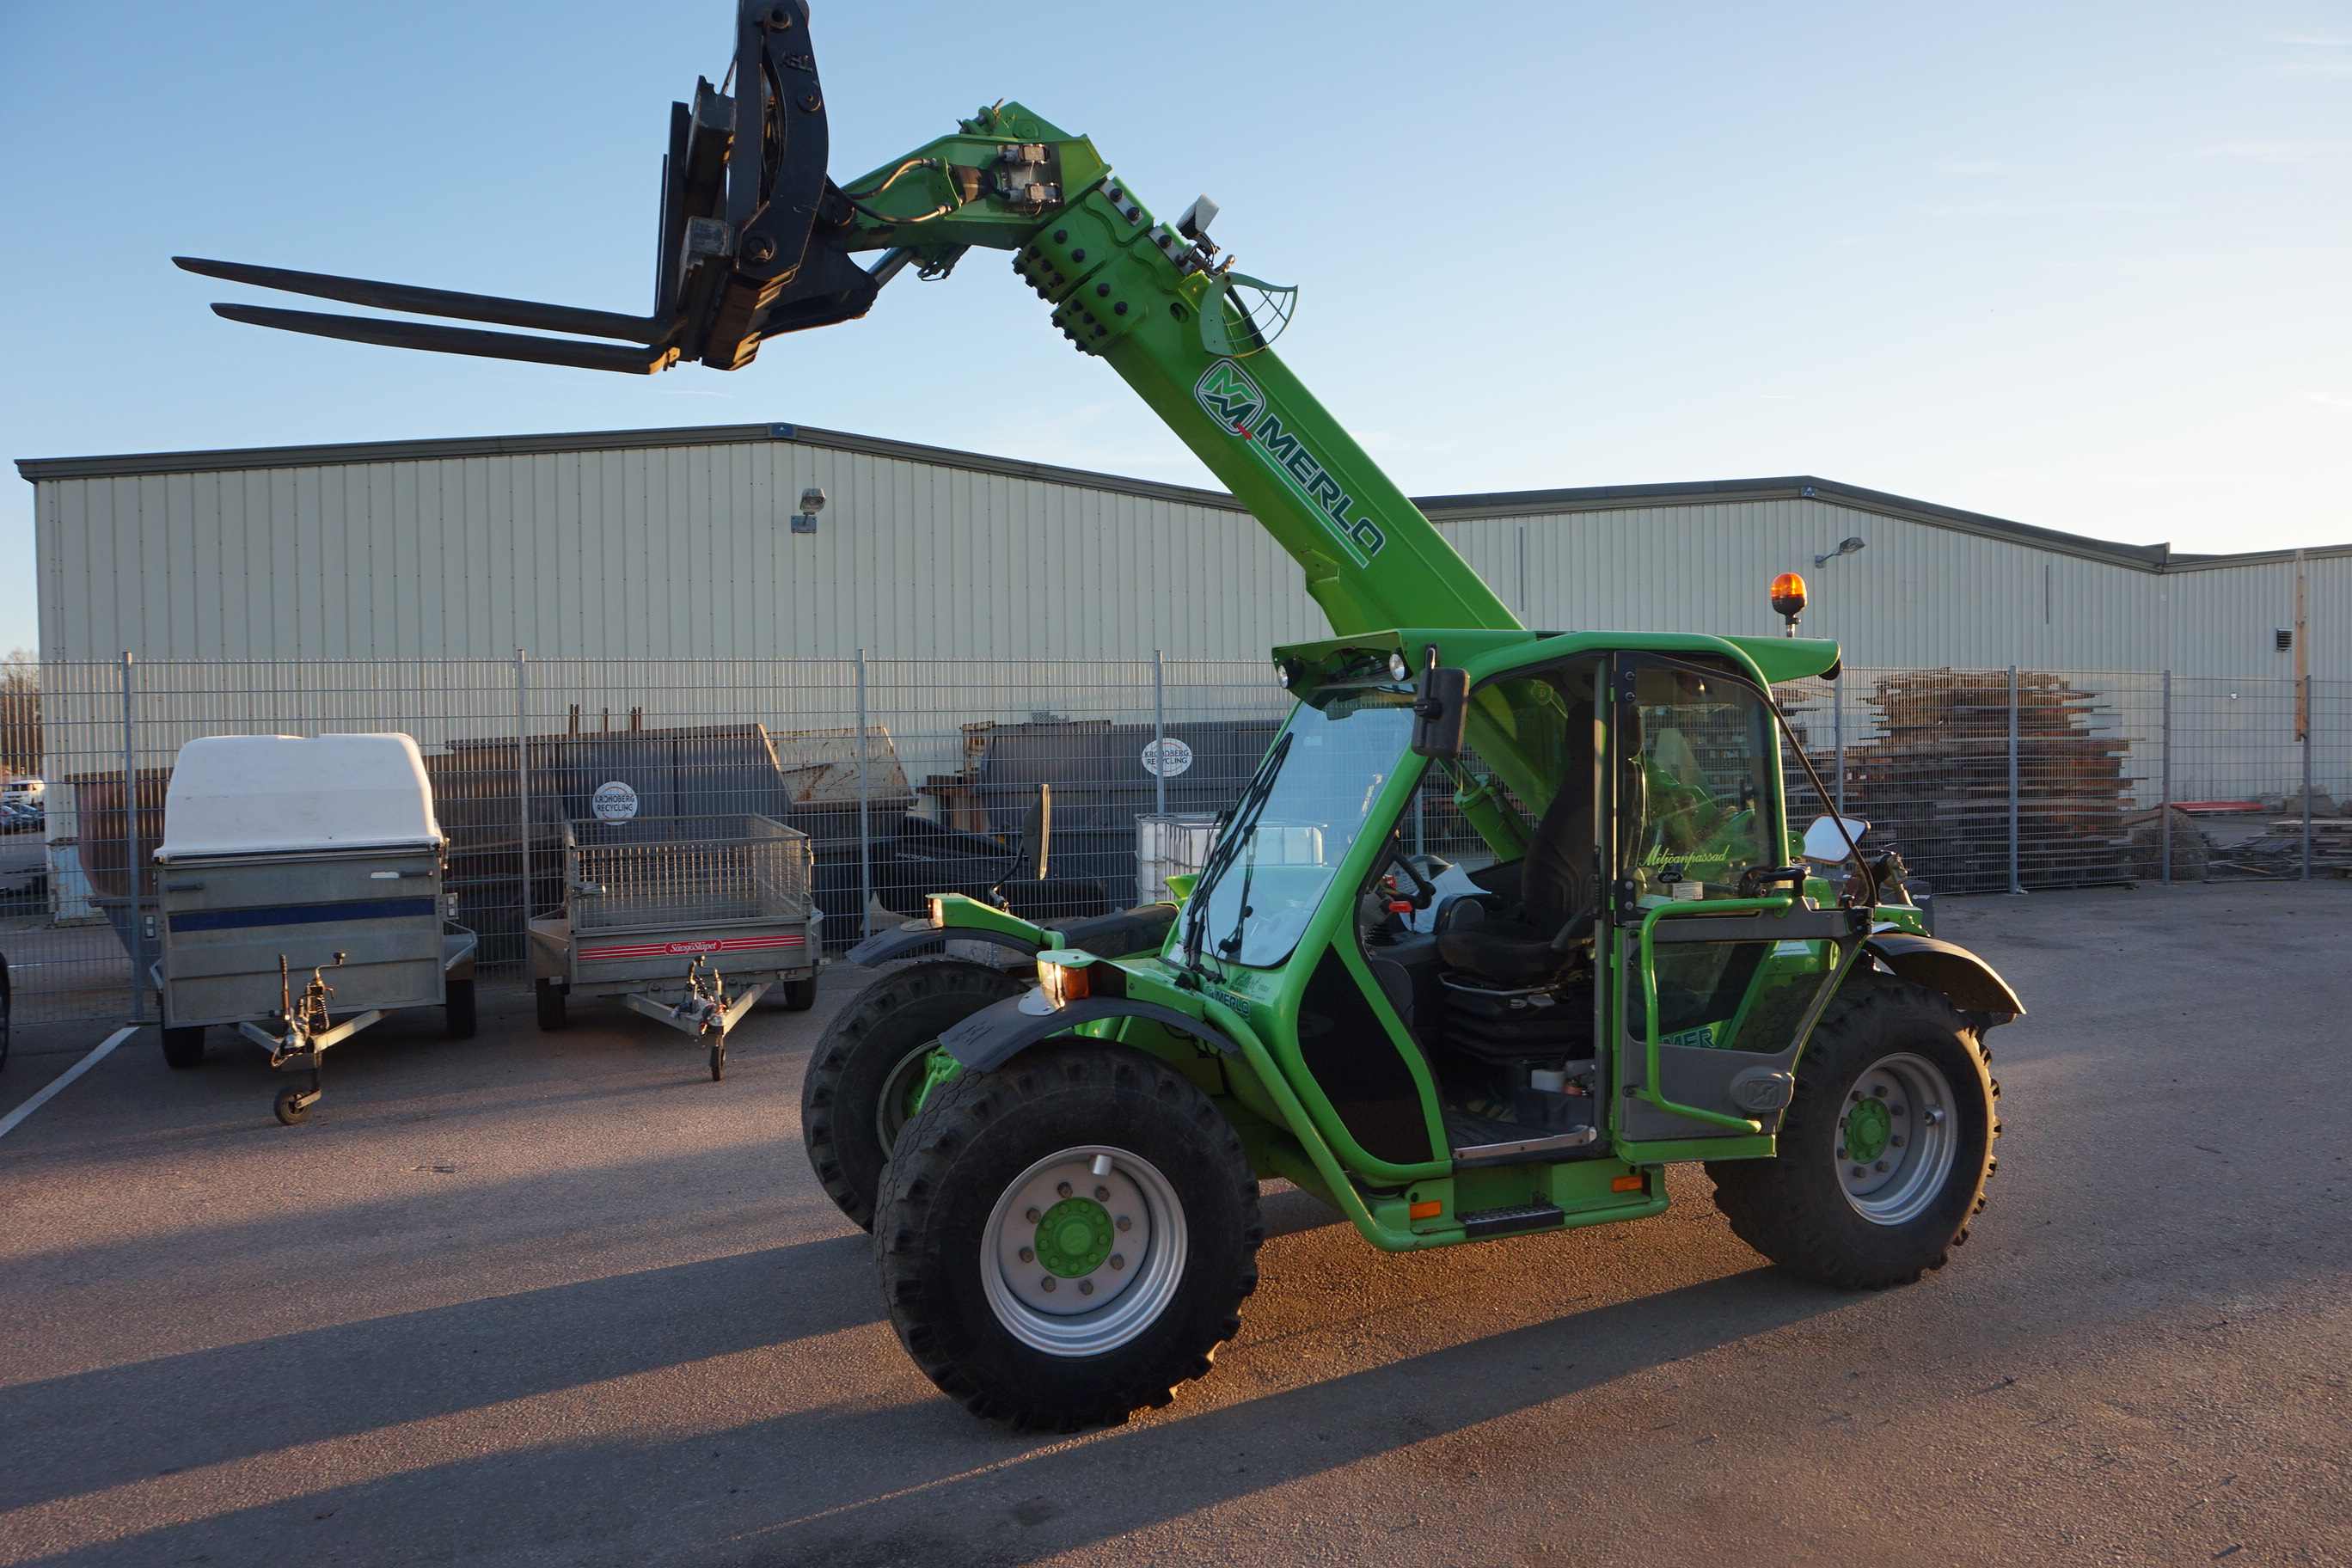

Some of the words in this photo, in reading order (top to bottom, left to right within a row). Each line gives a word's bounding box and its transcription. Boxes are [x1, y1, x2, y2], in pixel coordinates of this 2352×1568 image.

[1254, 413, 1386, 556] MERLO
[1639, 845, 1730, 873] Miljöanpassad
[1216, 989, 1250, 1015] MERLO
